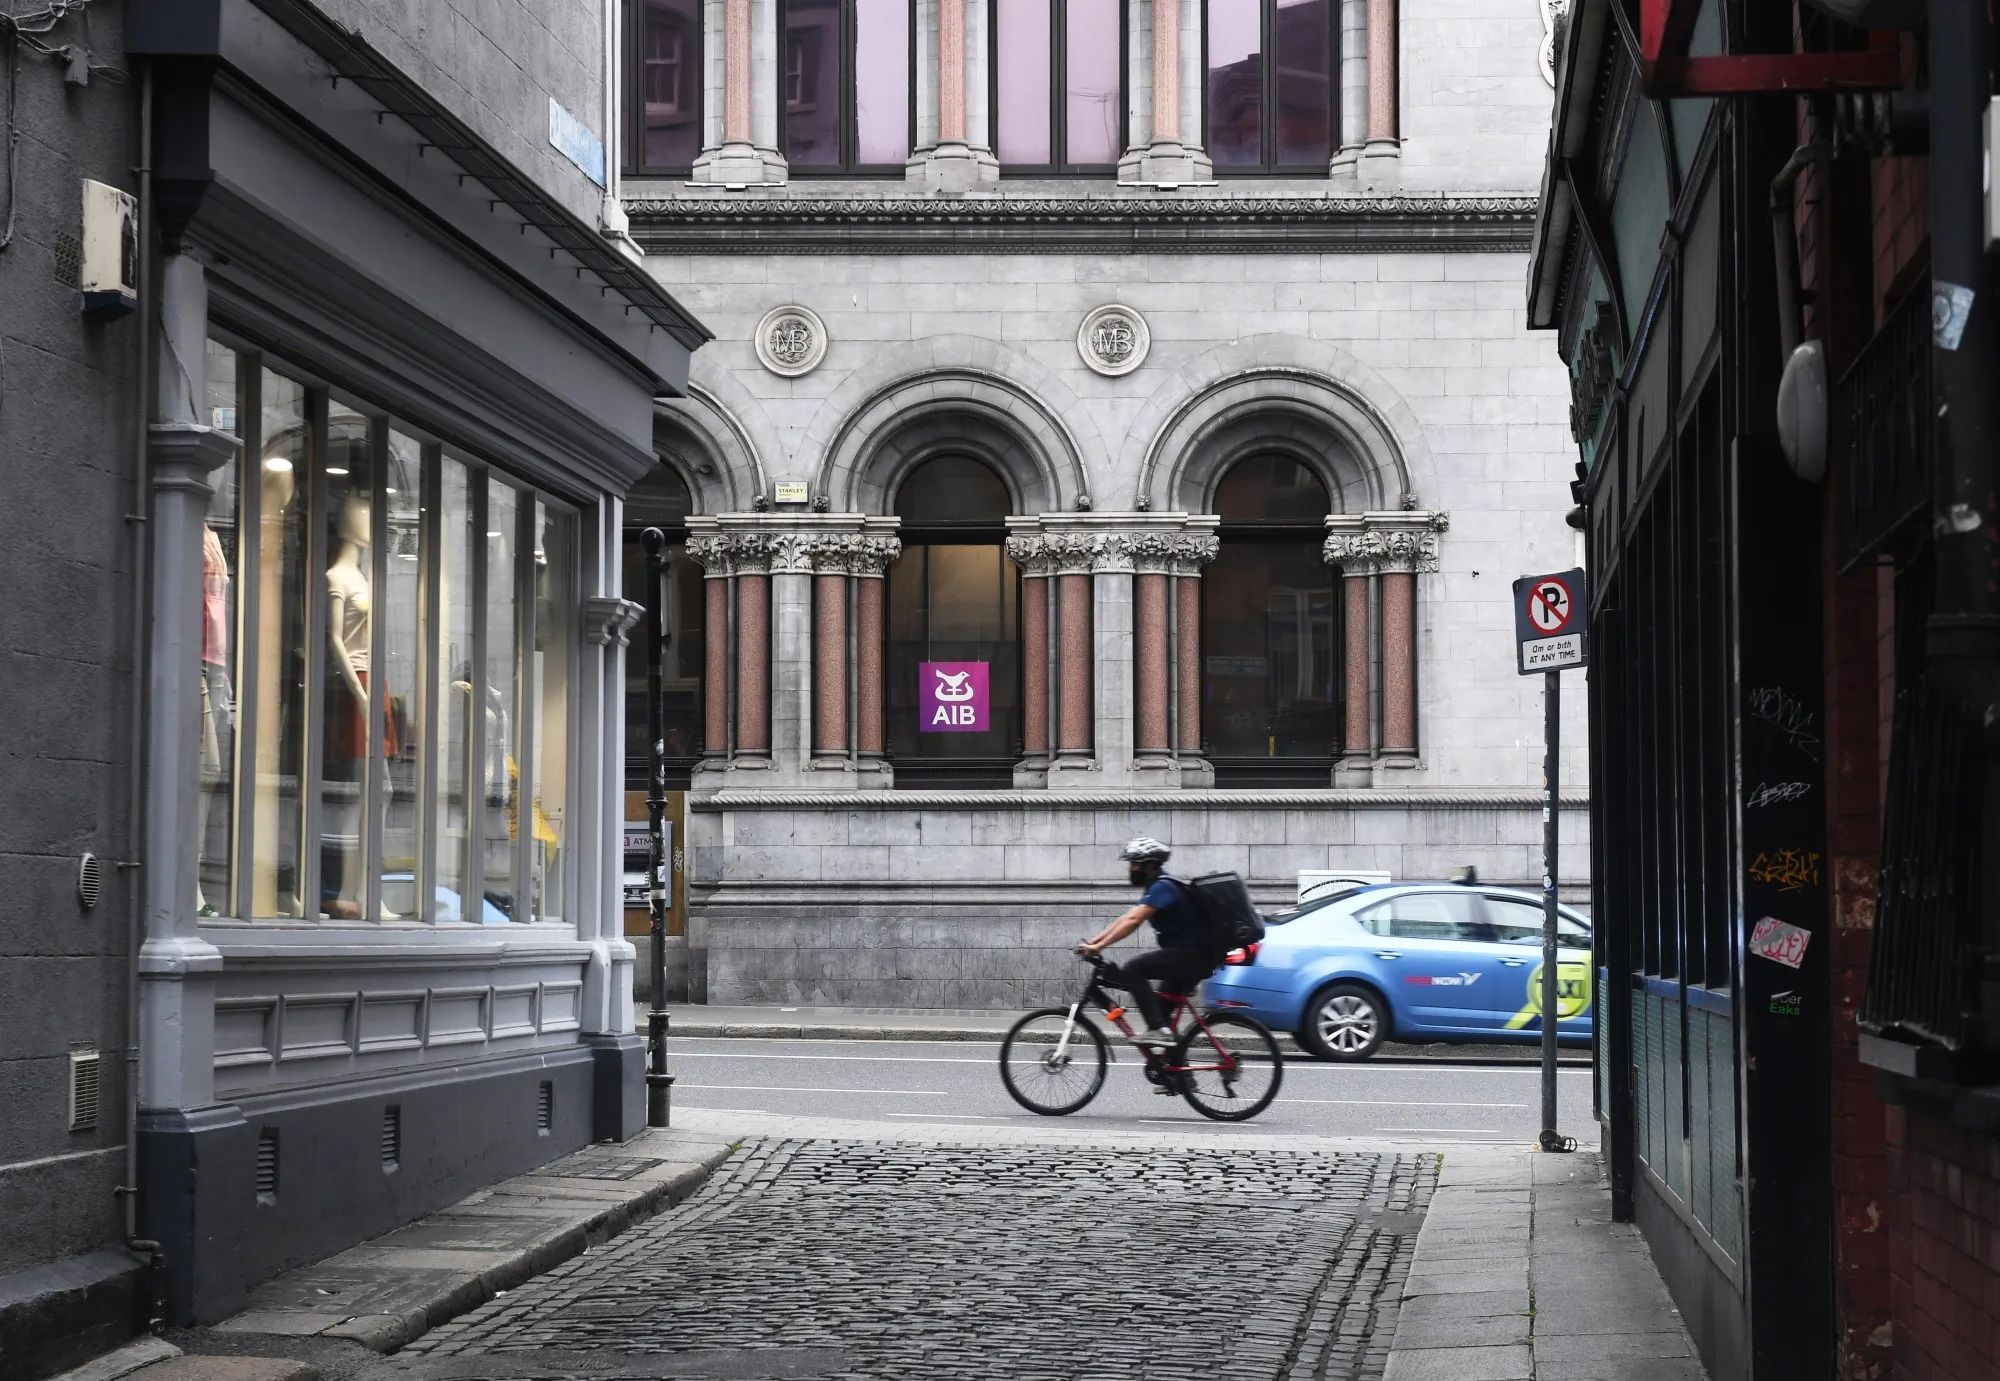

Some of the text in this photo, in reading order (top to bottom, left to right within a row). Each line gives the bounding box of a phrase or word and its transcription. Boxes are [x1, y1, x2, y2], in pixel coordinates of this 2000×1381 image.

[1529, 649, 1576, 664] AT ANY TIME
[931, 705, 976, 725] AIB
[1770, 993, 1802, 1005] ber
